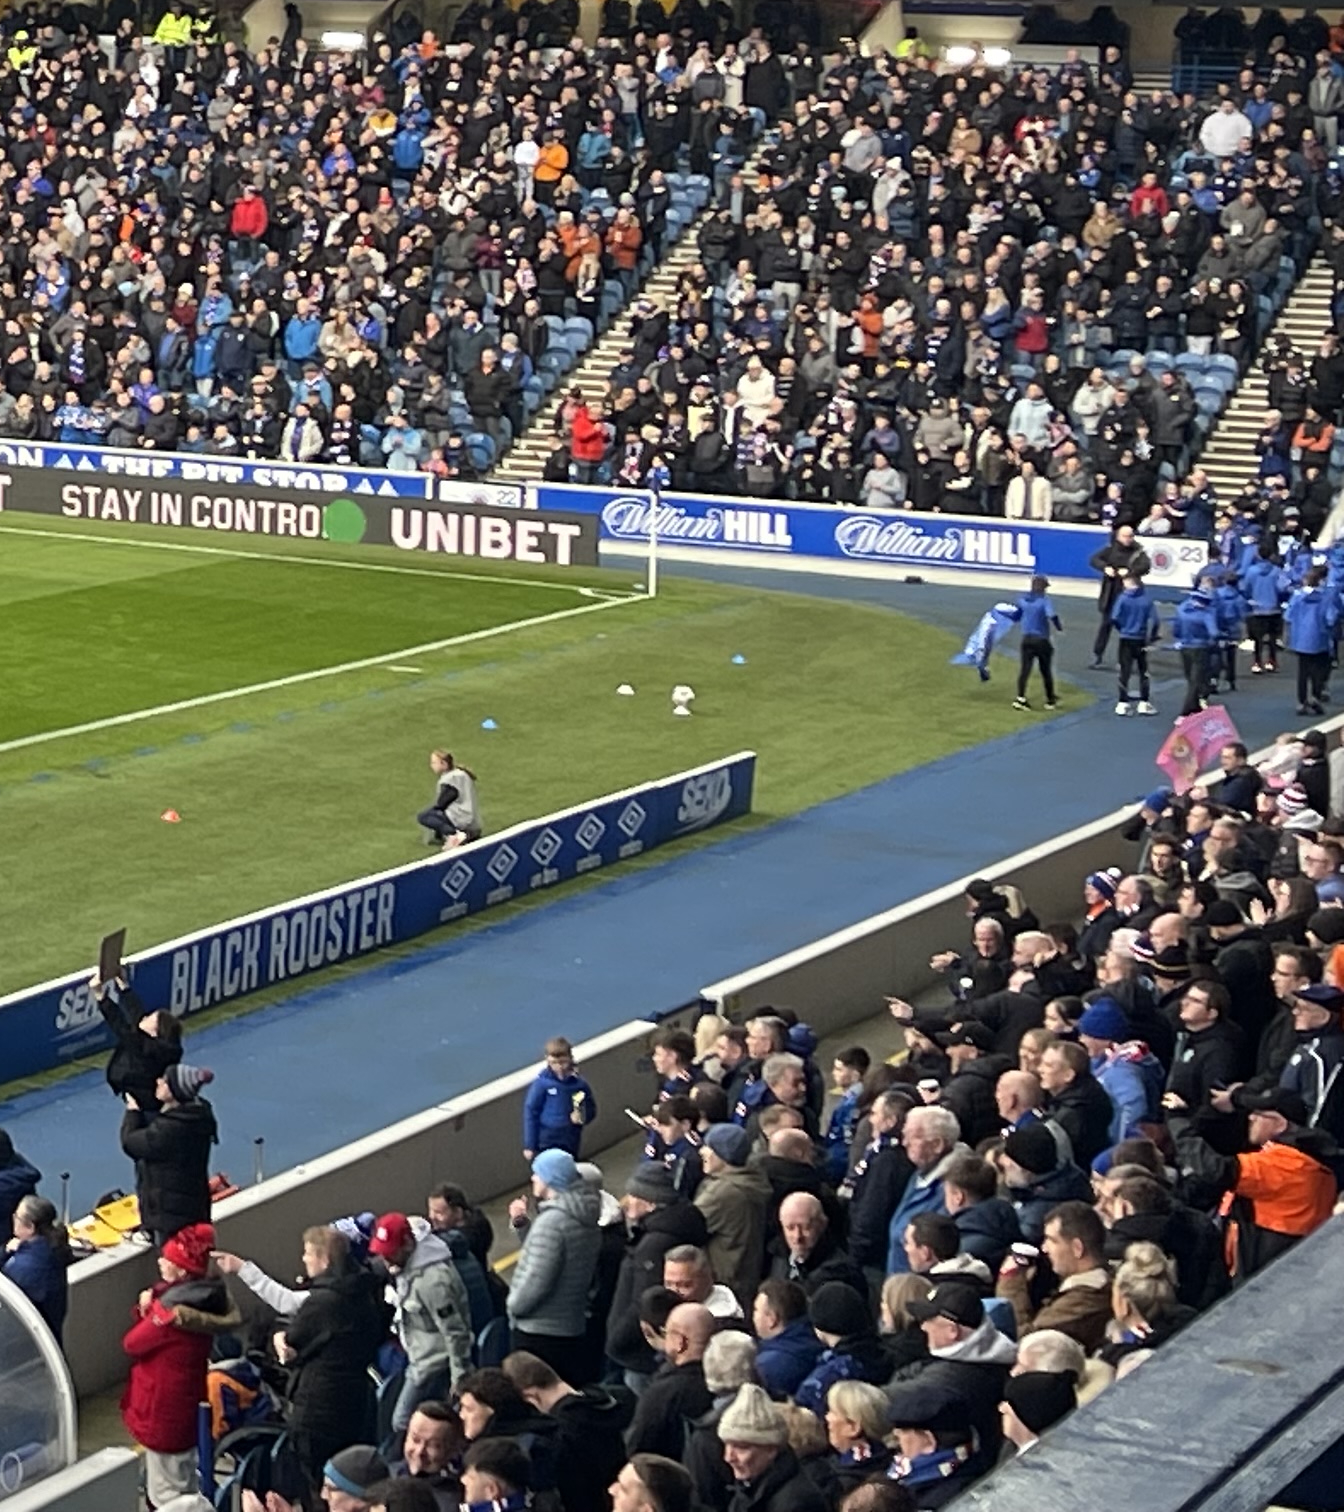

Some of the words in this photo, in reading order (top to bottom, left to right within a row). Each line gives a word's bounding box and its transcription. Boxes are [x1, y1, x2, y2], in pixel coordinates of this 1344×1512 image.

[62, 484, 142, 523] STAY
[150, 492, 182, 526] IN
[497, 490, 517, 506] 22
[603, 498, 723, 539] William
[725, 509, 792, 546] HILL
[391, 507, 581, 565] UNIBET
[835, 516, 964, 561] William
[964, 529, 1035, 567] HILL
[1179, 545, 1203, 563] 23
[169, 925, 261, 1017] BLACK
[269, 883, 395, 976] ROOSTER
